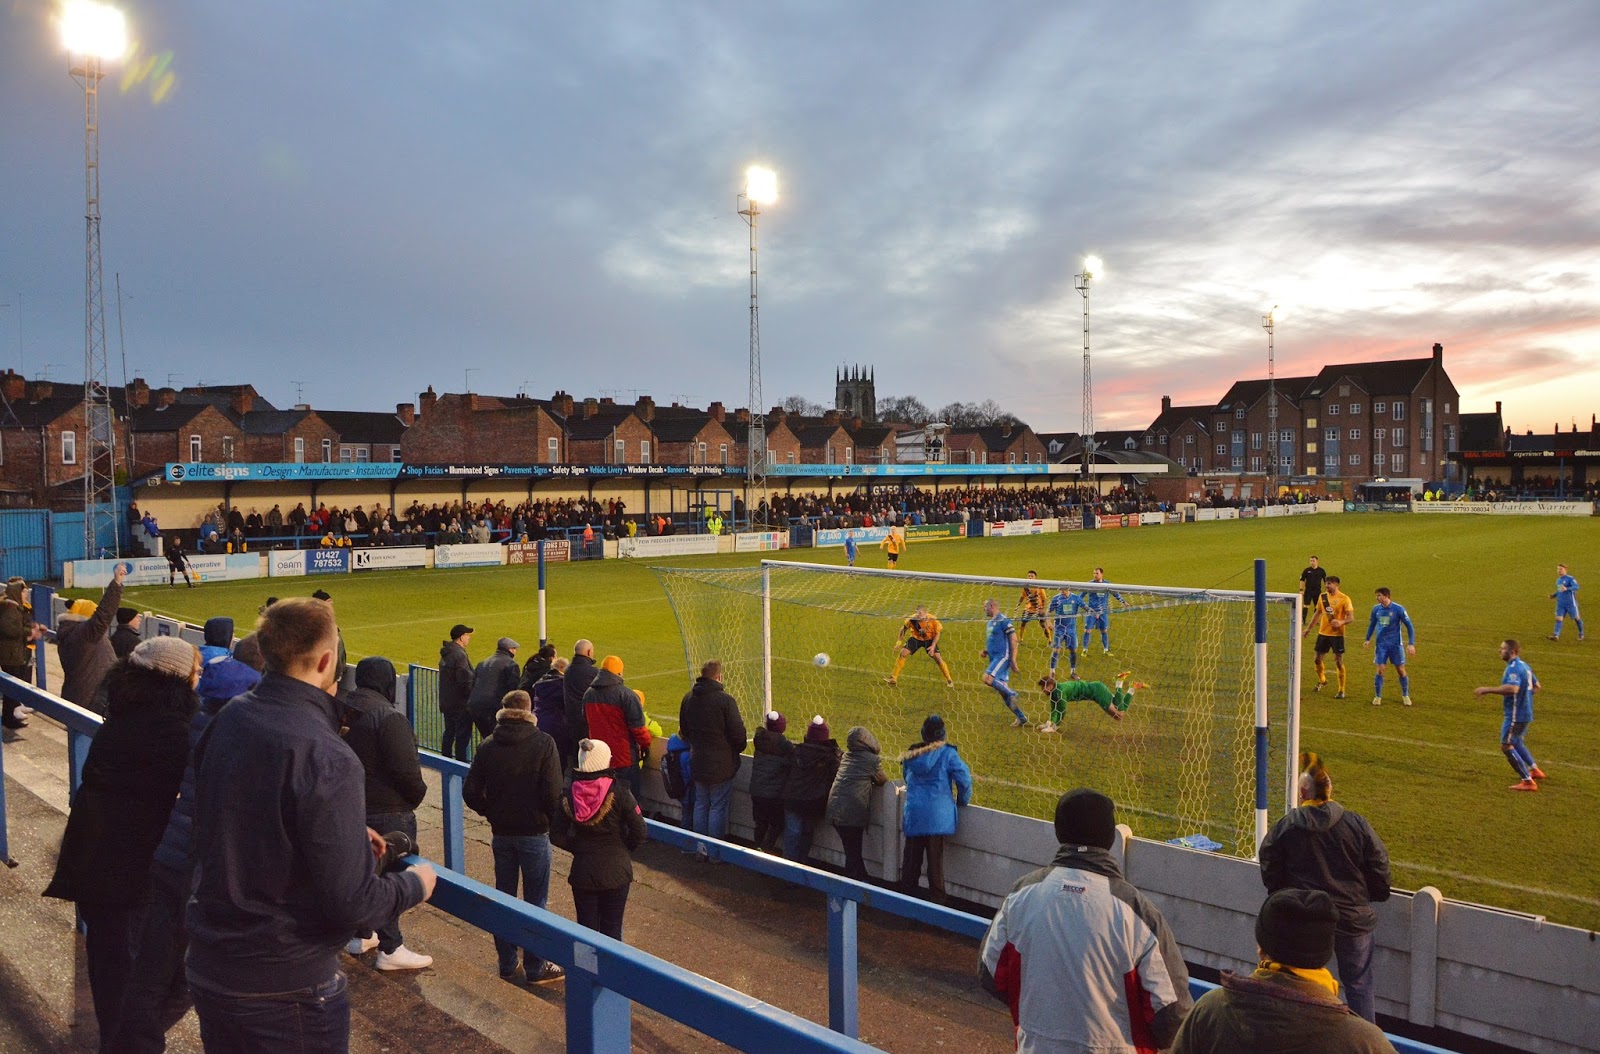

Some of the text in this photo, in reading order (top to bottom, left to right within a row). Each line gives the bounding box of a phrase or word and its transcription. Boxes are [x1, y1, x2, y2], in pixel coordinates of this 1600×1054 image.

[188, 464, 397, 480] elitesigns Design Manufacture Installation
[406, 466, 422, 476] Shop
[425, 466, 444, 474] Facias
[450, 466, 482, 474] Illuminated
[484, 466, 499, 476] Signs
[504, 466, 532, 474] Pavement
[533, 466, 548, 476] Signs
[552, 466, 570, 476] Safety
[571, 466, 584, 475] Signs
[590, 466, 606, 474] Vehicle
[608, 466, 623, 476] Livery
[628, 466, 648, 474] Window
[648, 466, 664, 474] Decals
[690, 466, 704, 475] Digital
[704, 466, 722, 475] Printing
[316, 551, 339, 559] 01427
[314, 559, 342, 567] 787532
[1063, 884, 1084, 892] RECCO
